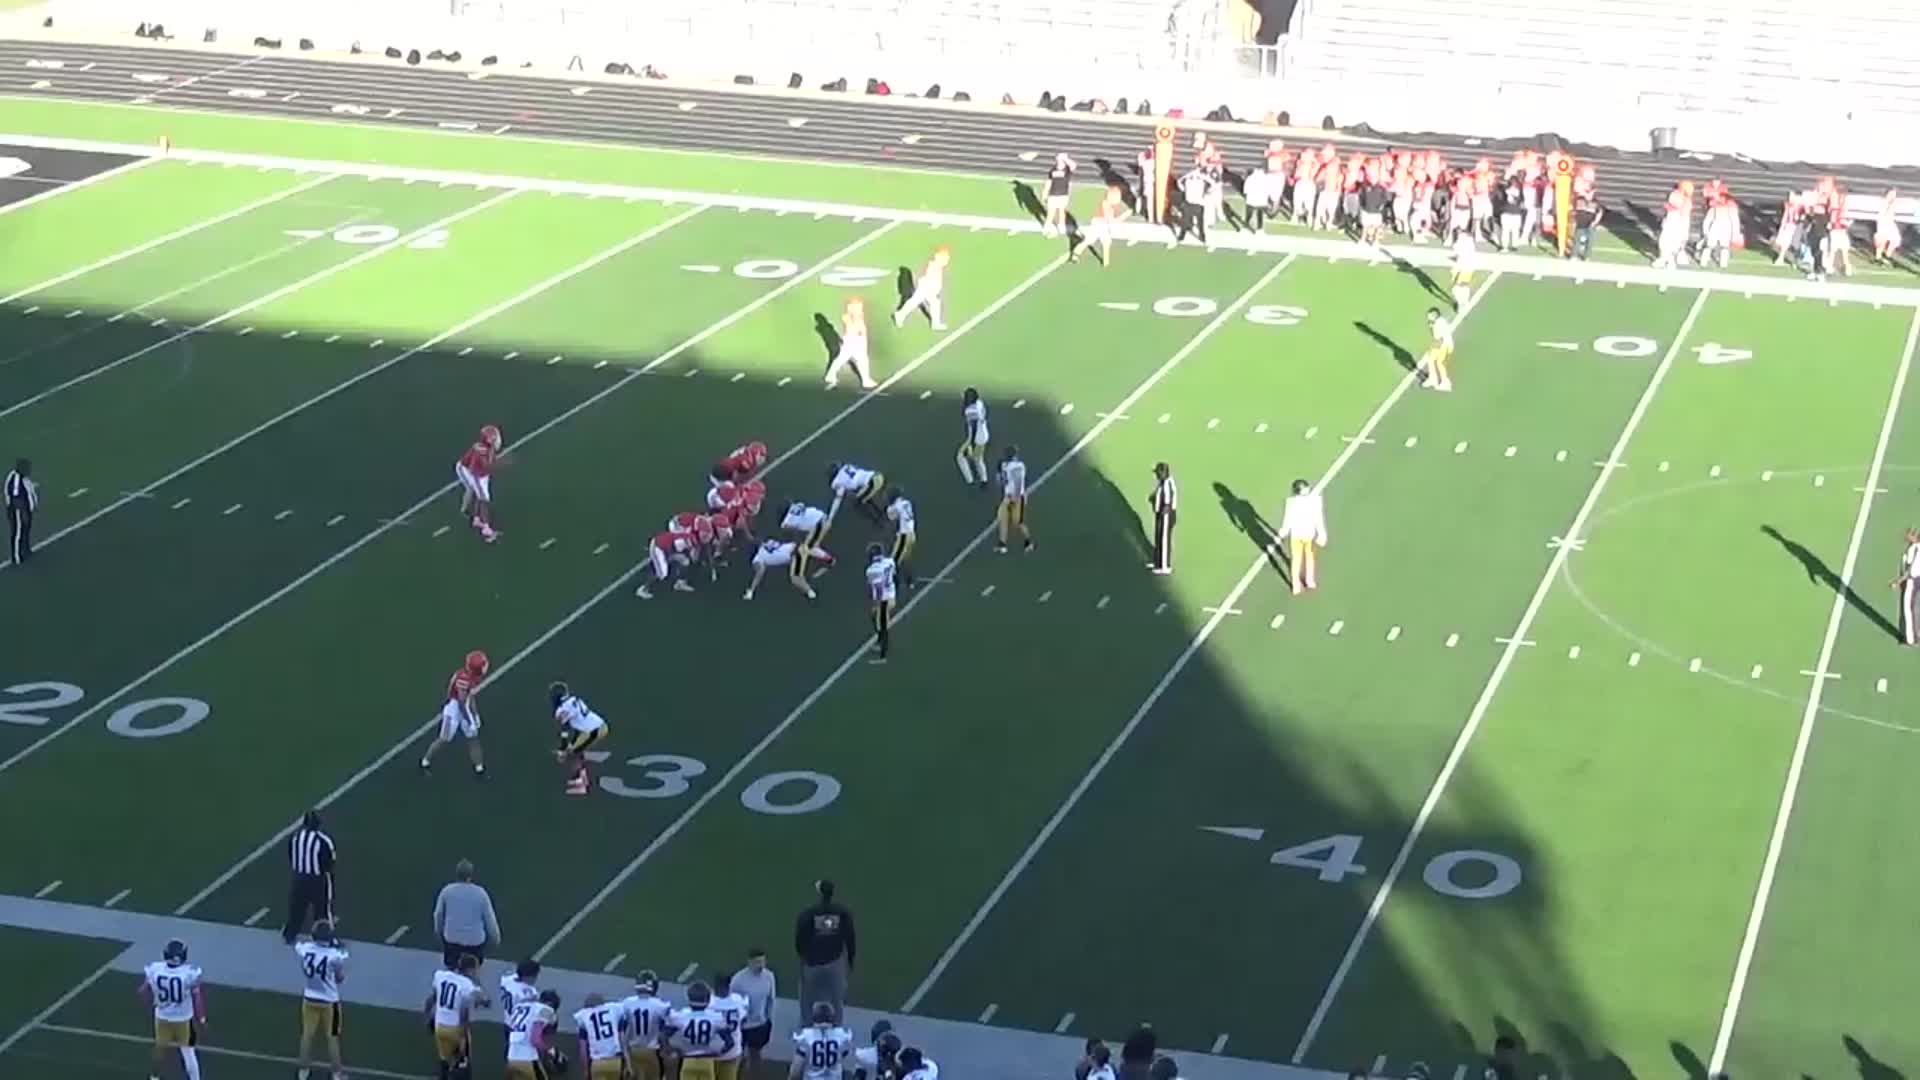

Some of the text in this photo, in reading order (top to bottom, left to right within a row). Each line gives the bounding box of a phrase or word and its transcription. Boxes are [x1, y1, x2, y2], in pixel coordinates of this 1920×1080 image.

[733, 260, 892, 287] 20
[1153, 296, 1309, 325] 30
[1593, 335, 1752, 364] 40
[0, 681, 211, 737] 20
[599, 754, 842, 815] 30
[1270, 834, 1522, 899] 40
[303, 952, 330, 981] 34
[156, 974, 184, 1004] 50
[440, 979, 459, 1011] 10
[588, 1010, 615, 1041] 15
[633, 1008, 650, 1036] 11
[683, 1018, 713, 1047] 48
[811, 1039, 839, 1068] 66
